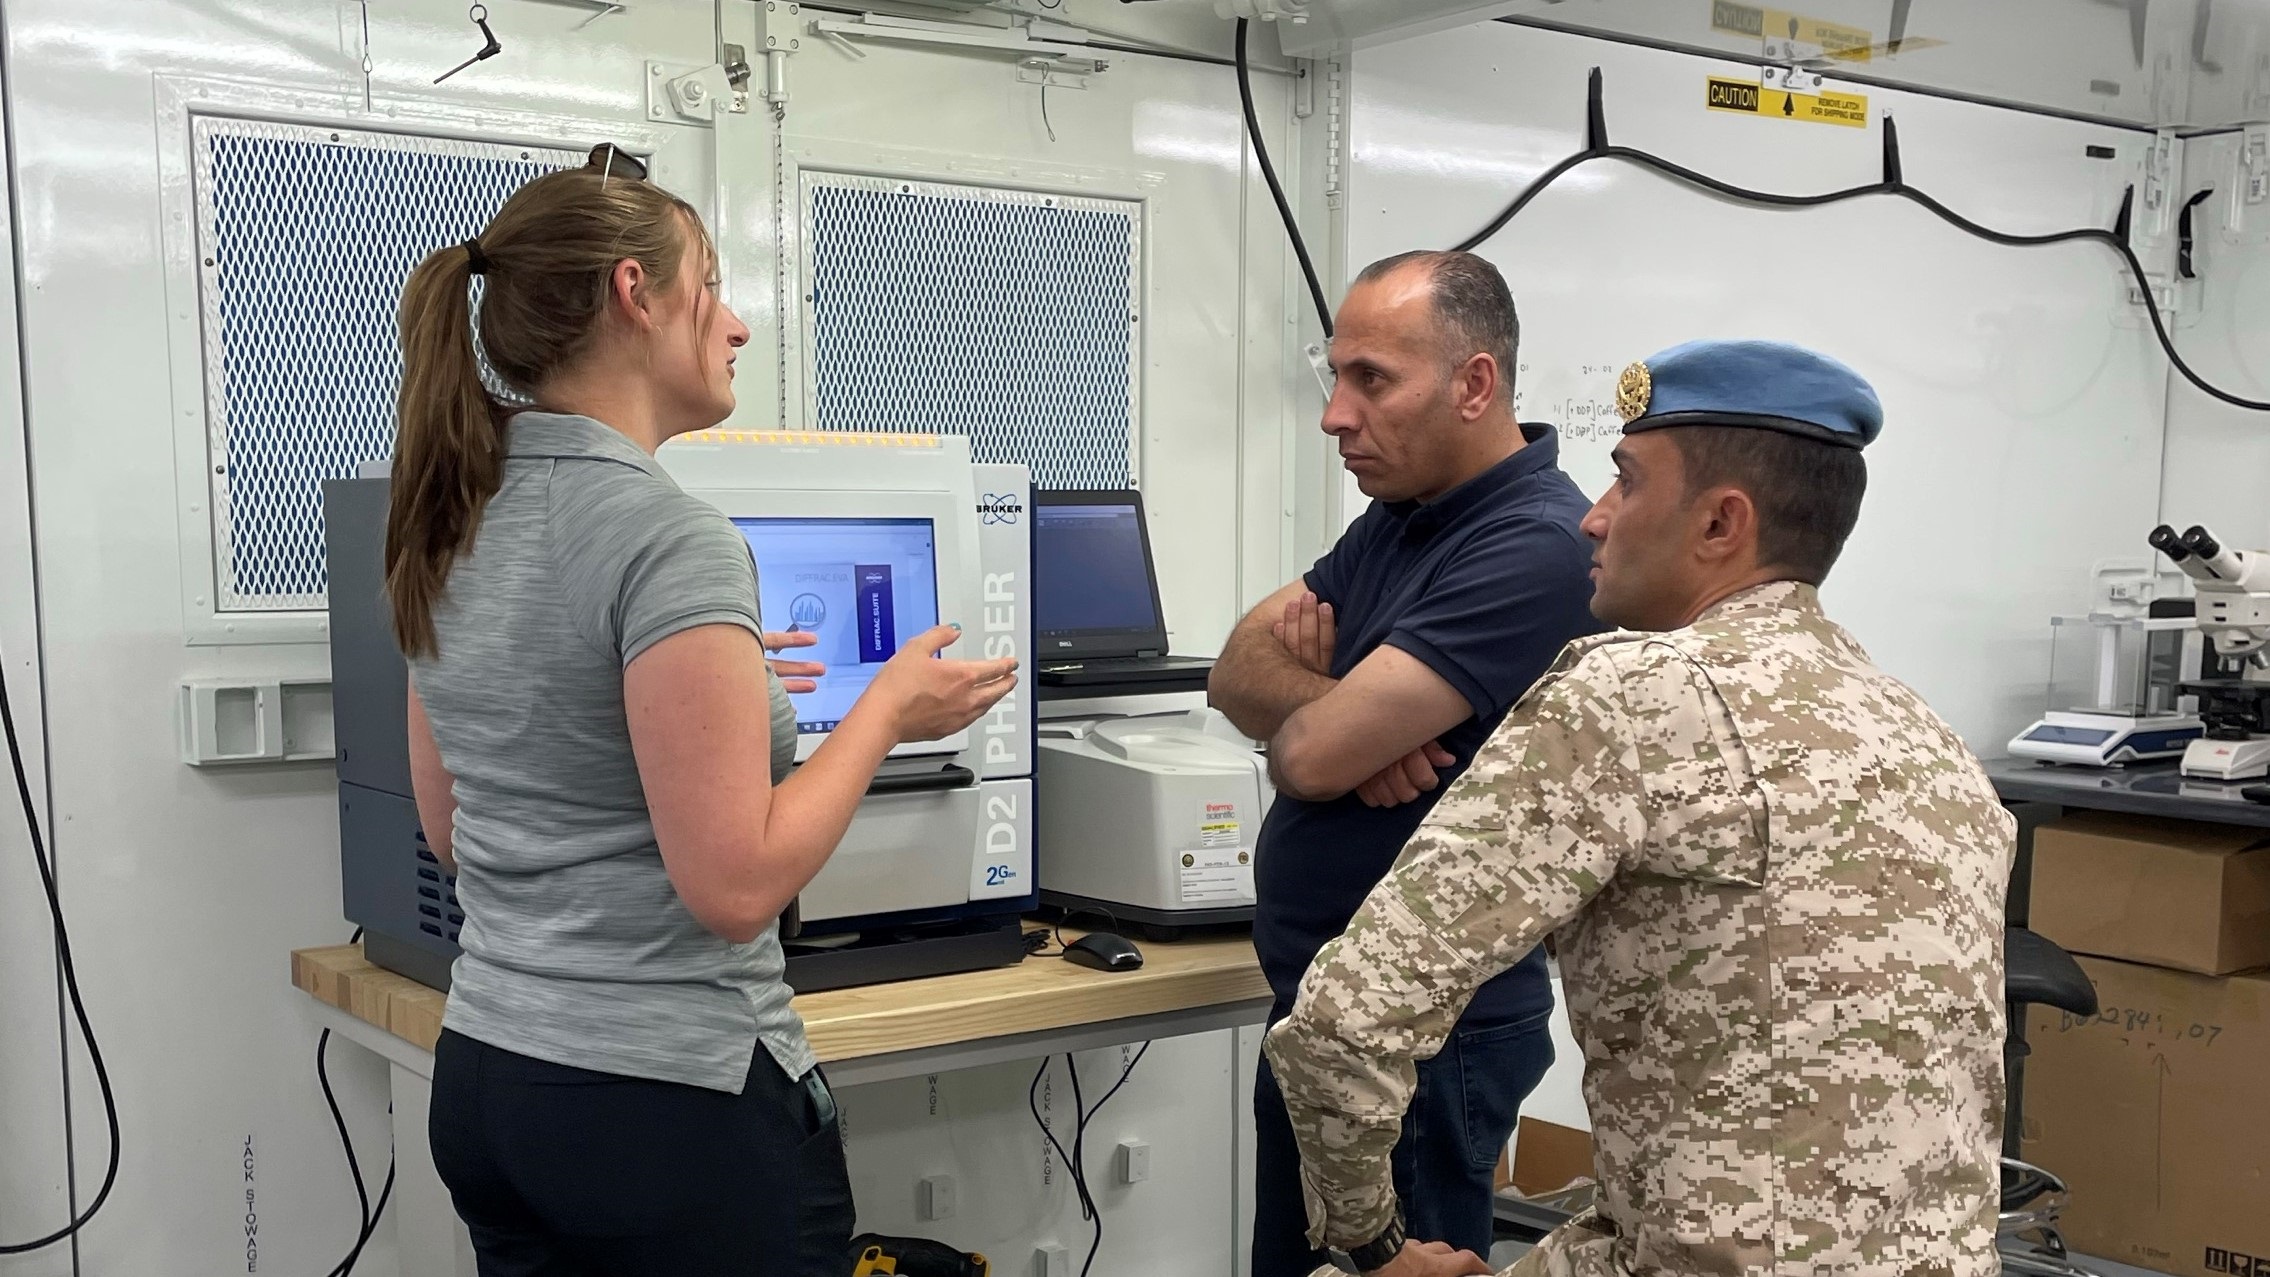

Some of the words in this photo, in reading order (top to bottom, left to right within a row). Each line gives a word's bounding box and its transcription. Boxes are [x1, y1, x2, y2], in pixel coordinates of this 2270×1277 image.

[1711, 84, 1757, 107] CAUTION
[1811, 106, 1823, 116] FOR
[1824, 108, 1849, 119] SHIPPING
[1818, 97, 1842, 108] REMOVE
[976, 503, 1022, 514] BRUKER
[984, 571, 1017, 764] PHSER
[986, 794, 1017, 854] D2
[1206, 804, 1233, 812] thermo
[1043, 1073, 1052, 1112] JACK
[243, 1134, 254, 1182] JACK
[1043, 1117, 1052, 1185] SOWAGE
[244, 1189, 258, 1273] STOWAGE
